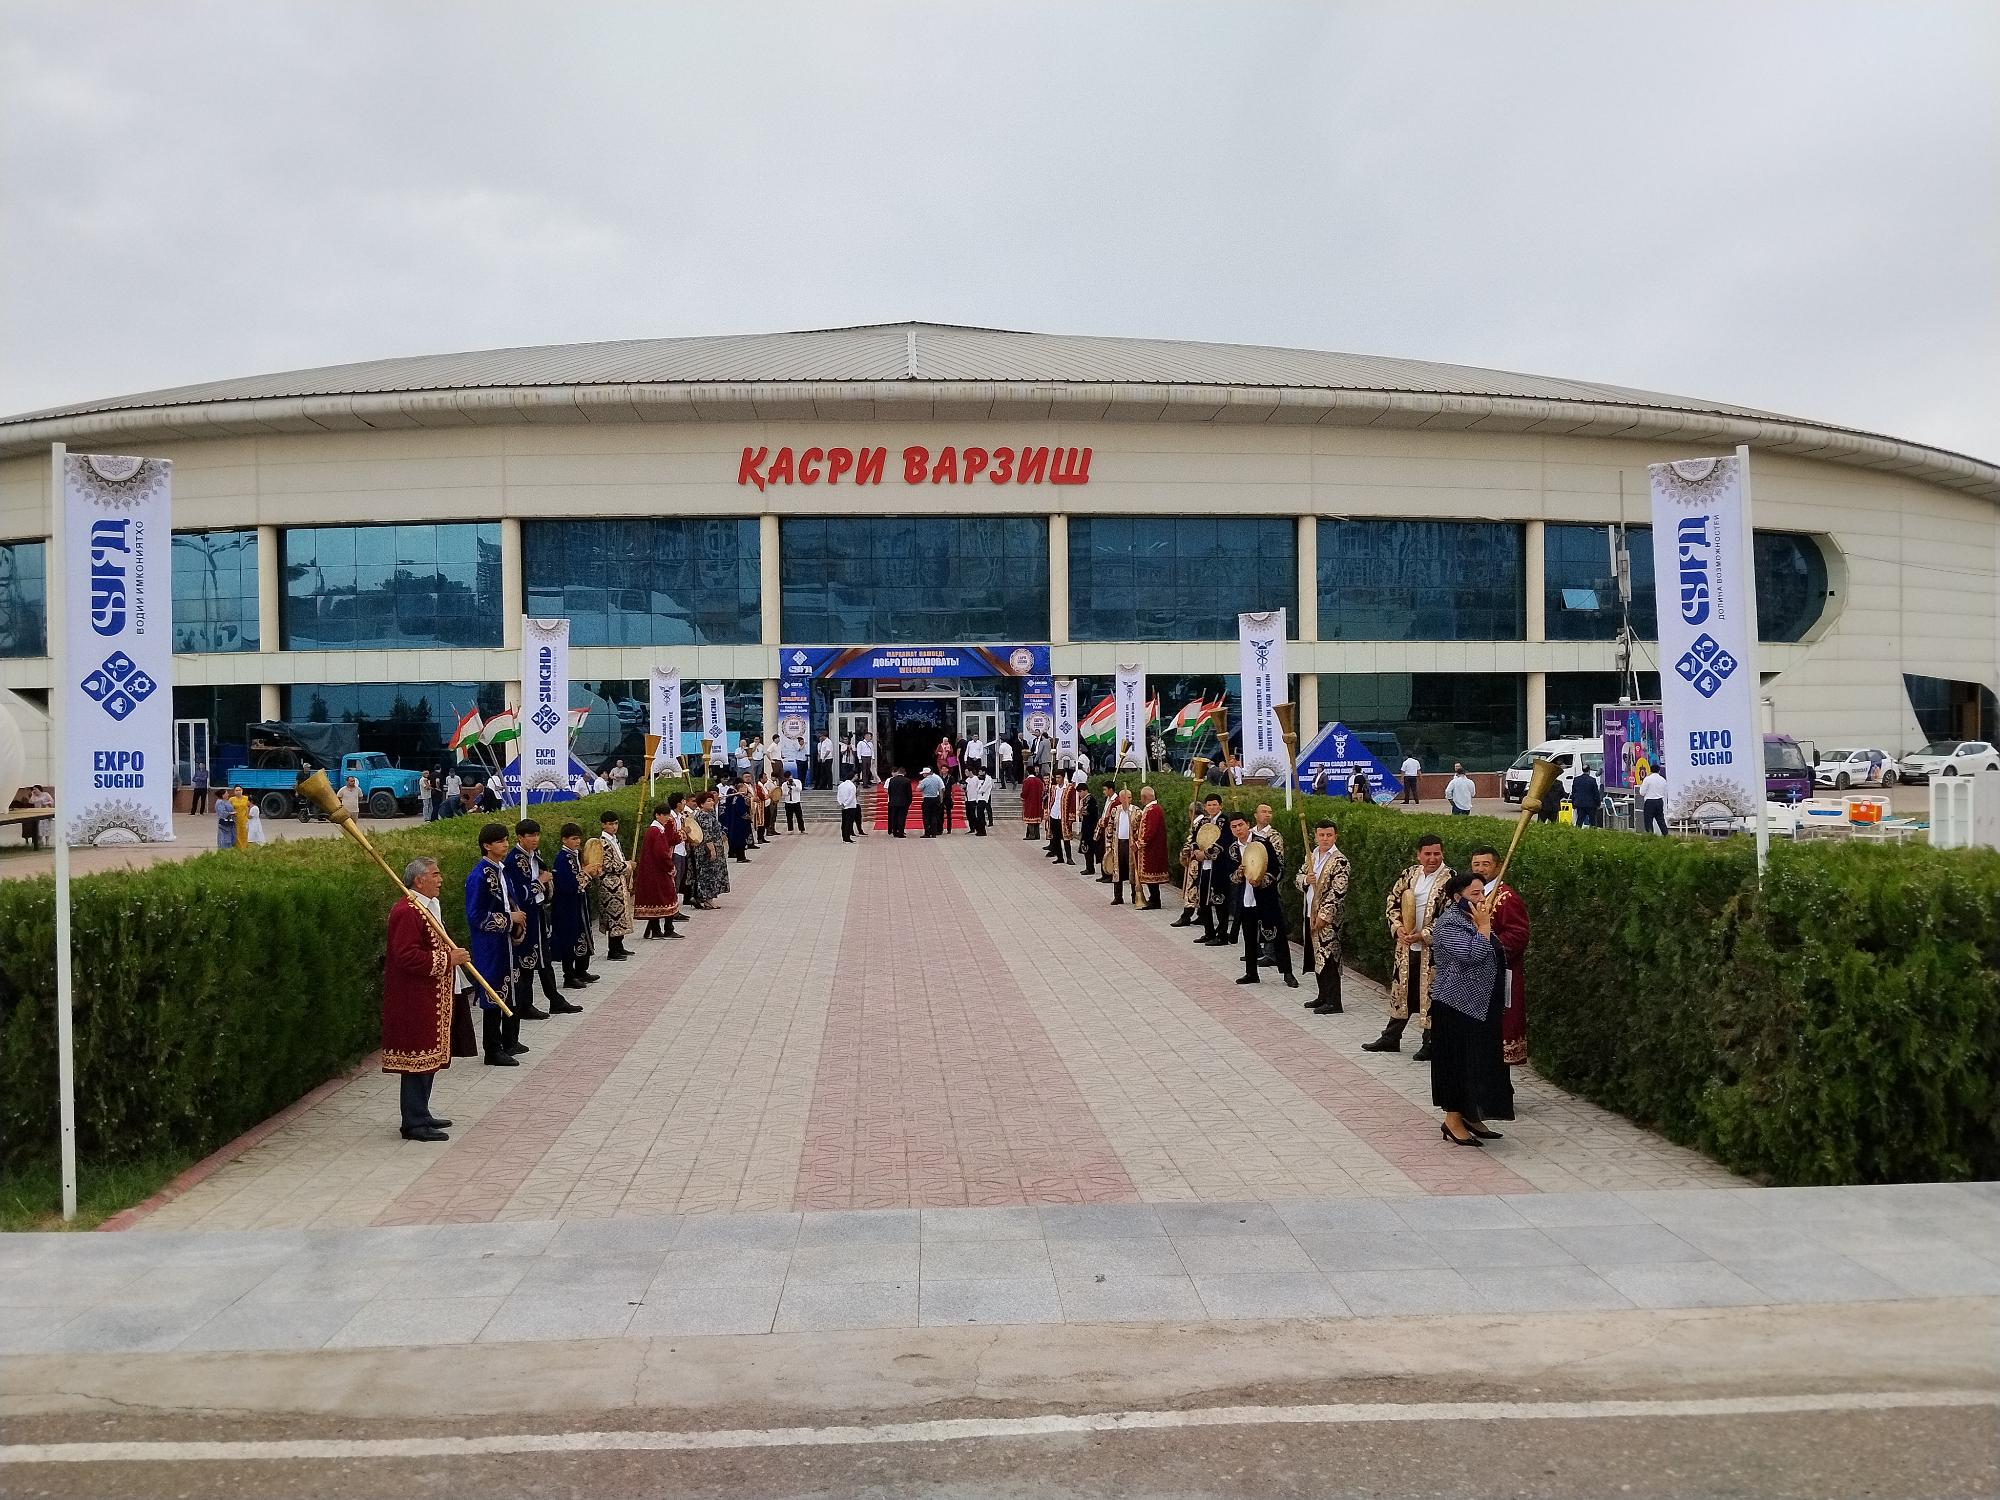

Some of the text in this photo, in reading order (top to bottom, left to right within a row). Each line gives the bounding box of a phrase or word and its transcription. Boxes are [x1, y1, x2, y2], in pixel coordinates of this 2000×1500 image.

[738, 446, 1093, 492] ҚАСРИ ВАРЗИШ
[91, 519, 131, 637] СУҒД
[1678, 515, 1711, 625] СУҒД
[1717, 586, 1725, 620] ДОЛИНА
[873, 658, 959, 667] ДОБРО ПОЖАЛОВАТЬ!
[1690, 730, 1731, 750] EXPO
[94, 751, 144, 771] EXPO
[536, 748, 556, 758] EXPO
[1690, 751, 1732, 766] SUGHD
[94, 774, 144, 788] SUGHD
